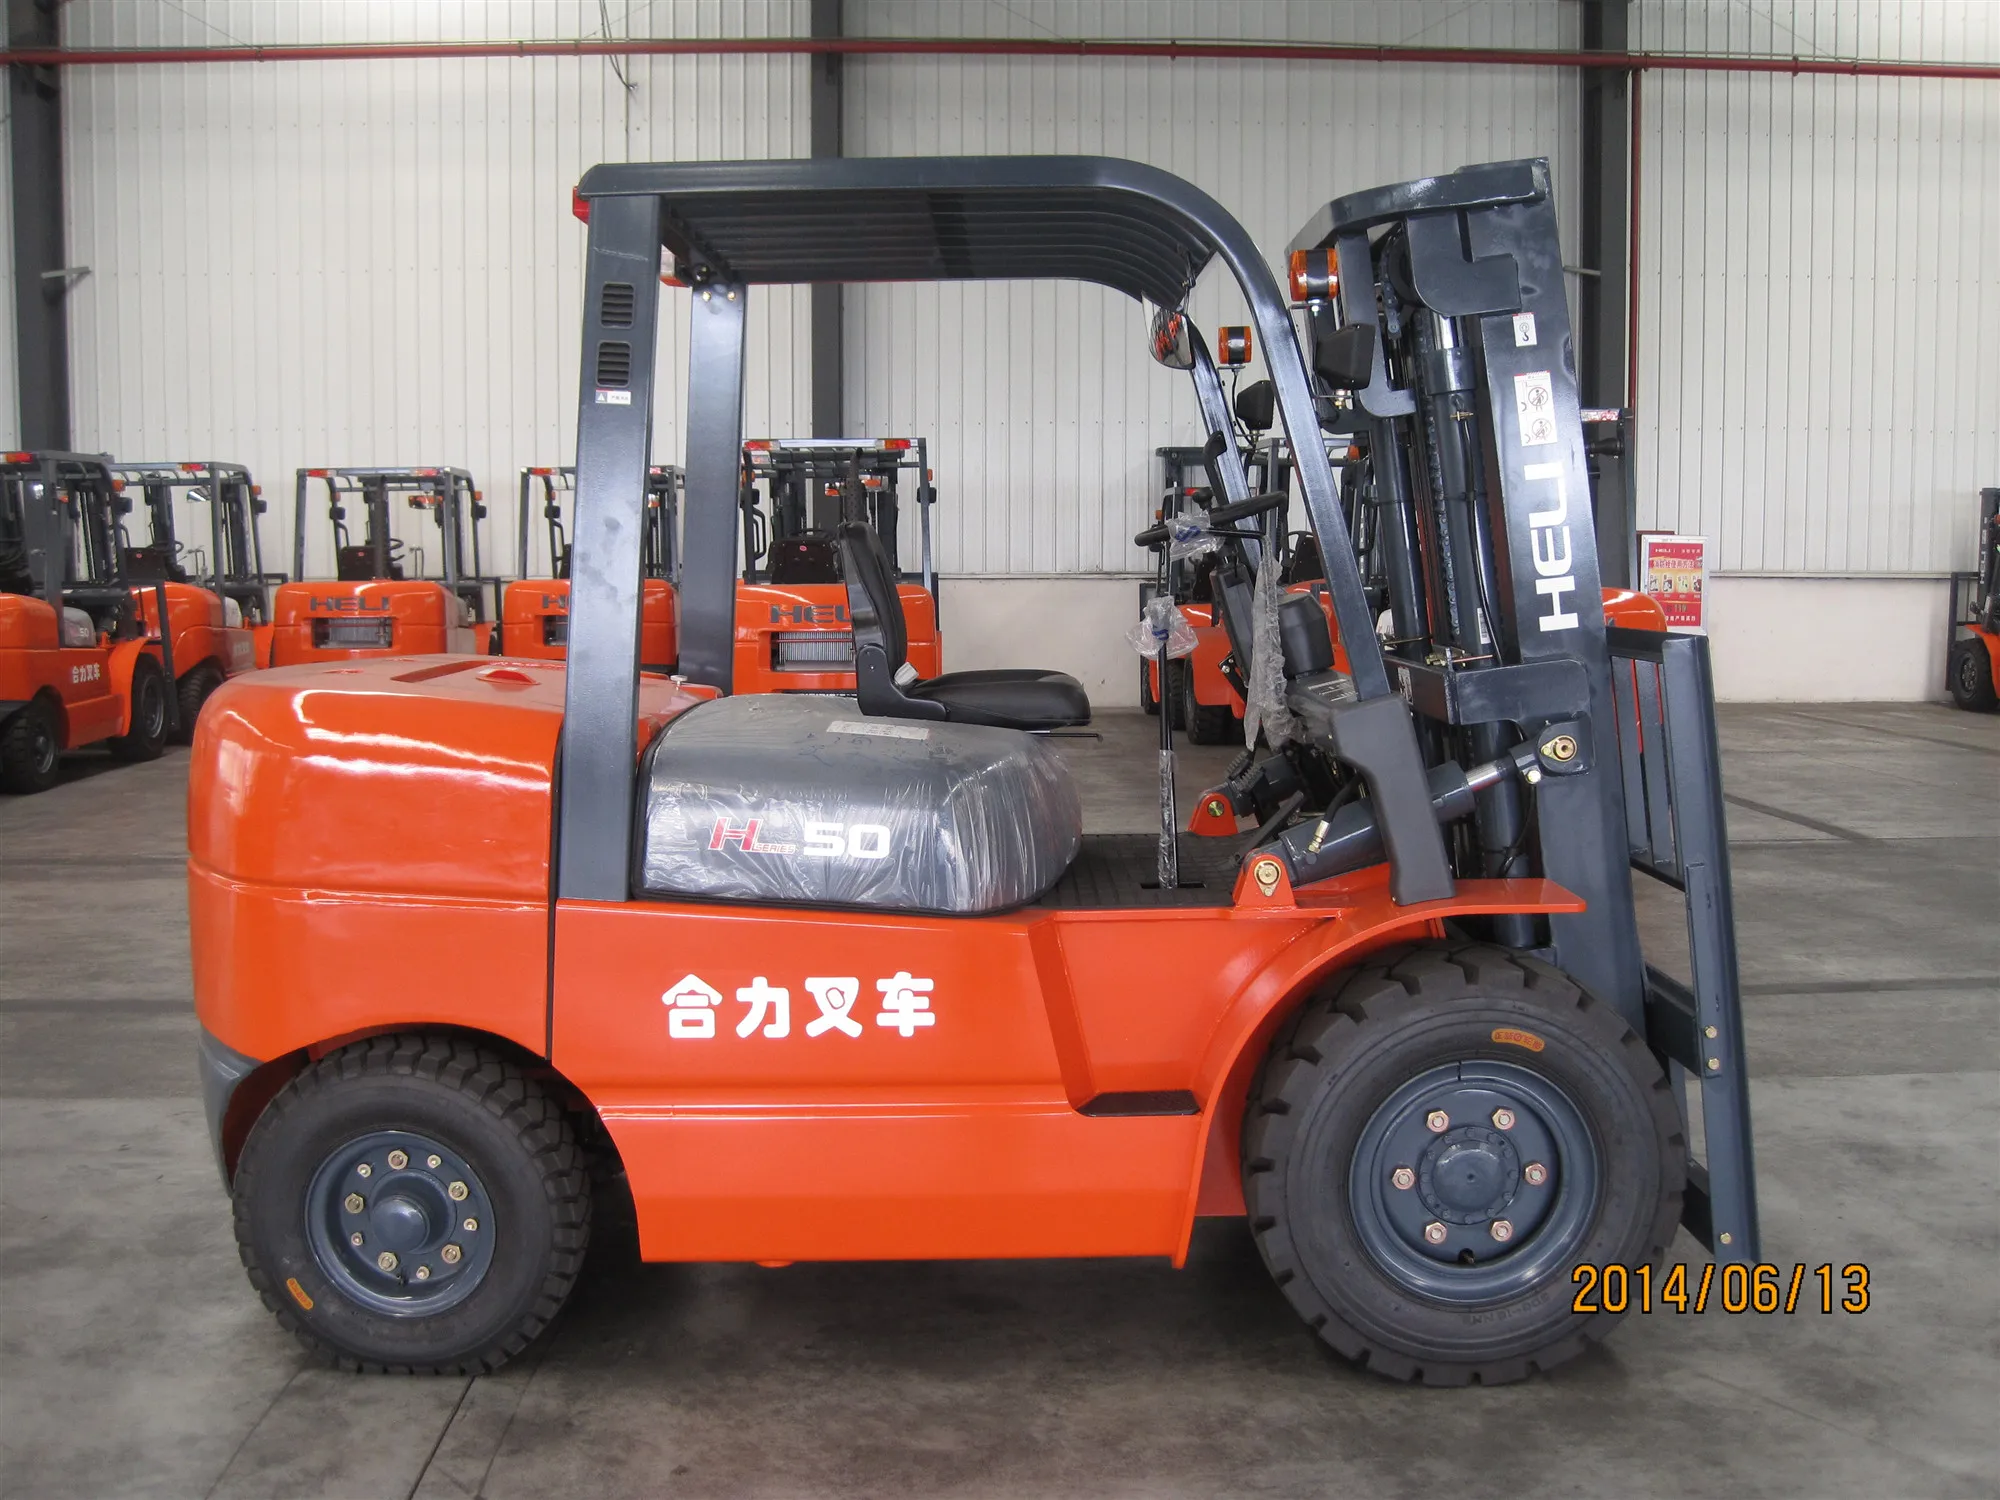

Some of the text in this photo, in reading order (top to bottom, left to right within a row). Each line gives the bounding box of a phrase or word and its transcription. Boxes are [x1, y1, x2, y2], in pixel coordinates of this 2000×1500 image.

[1523, 461, 1579, 632] HELI
[310, 596, 390, 612] HELI
[770, 605, 853, 624] HEL
[72, 662, 101, 684] 合力叉车
[708, 816, 891, 859] H SERIES 50
[661, 971, 936, 1039] 合力叉车
